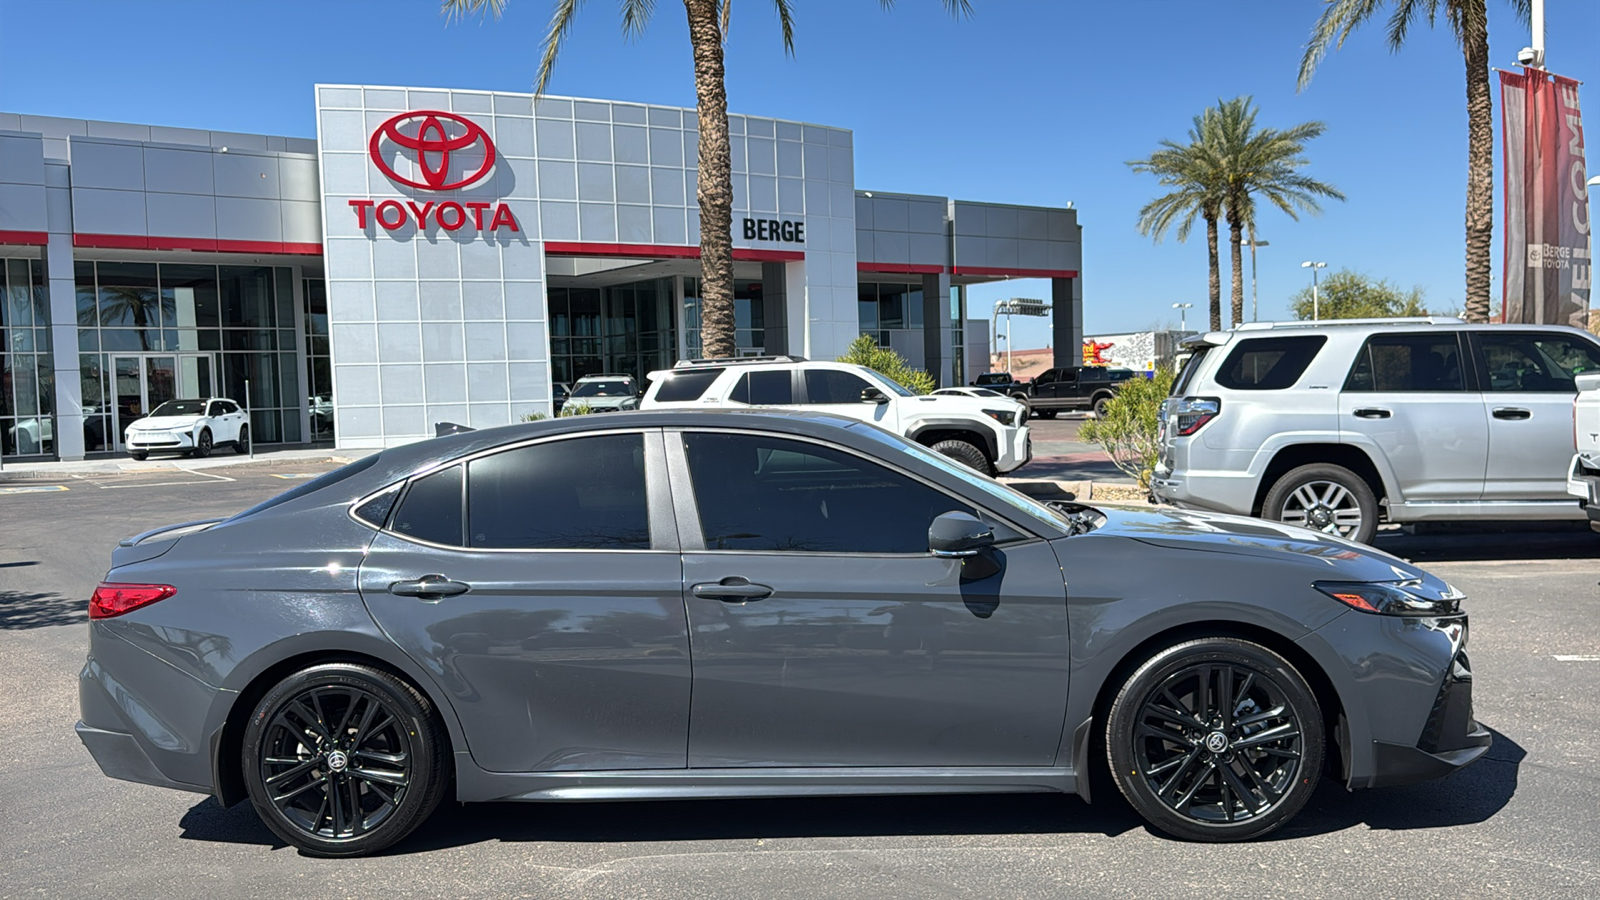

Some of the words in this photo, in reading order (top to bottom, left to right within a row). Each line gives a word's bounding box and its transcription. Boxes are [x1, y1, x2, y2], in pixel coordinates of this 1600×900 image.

[348, 199, 519, 232] TOYOTA
[1562, 83, 1591, 329] WELCOME
[743, 218, 805, 243] BERGE
[1543, 243, 1571, 259] BERGE
[1543, 259, 1570, 270] TOYOTA
